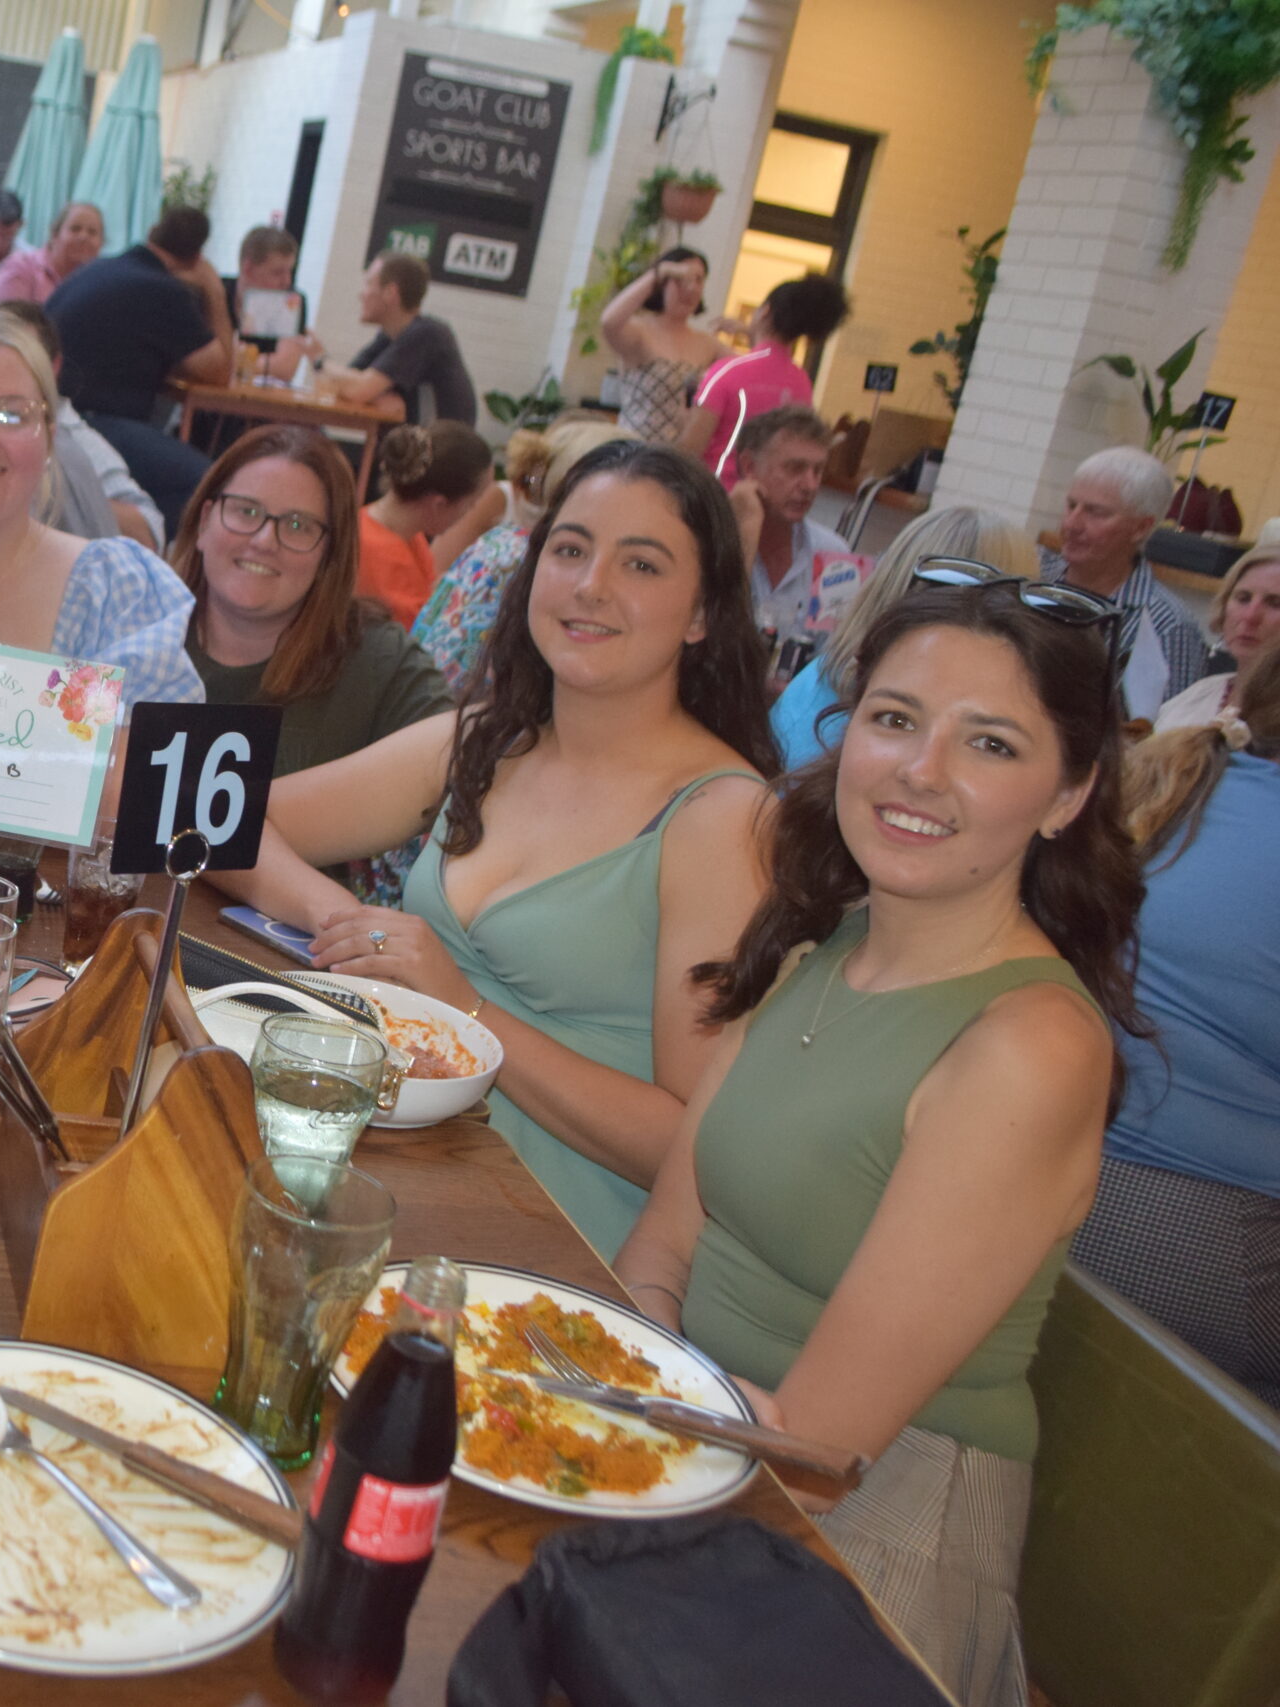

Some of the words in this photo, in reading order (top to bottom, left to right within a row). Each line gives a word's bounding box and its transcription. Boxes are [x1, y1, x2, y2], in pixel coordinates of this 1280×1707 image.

[412, 76, 488, 117] GOAT
[494, 93, 551, 130] CLUB
[402, 128, 488, 171] SPORTS
[495, 145, 541, 181] BAR
[454, 241, 507, 269] ATM
[1201, 396, 1232, 427] 17
[7, 763, 21, 778] B
[150, 731, 252, 847] 16
